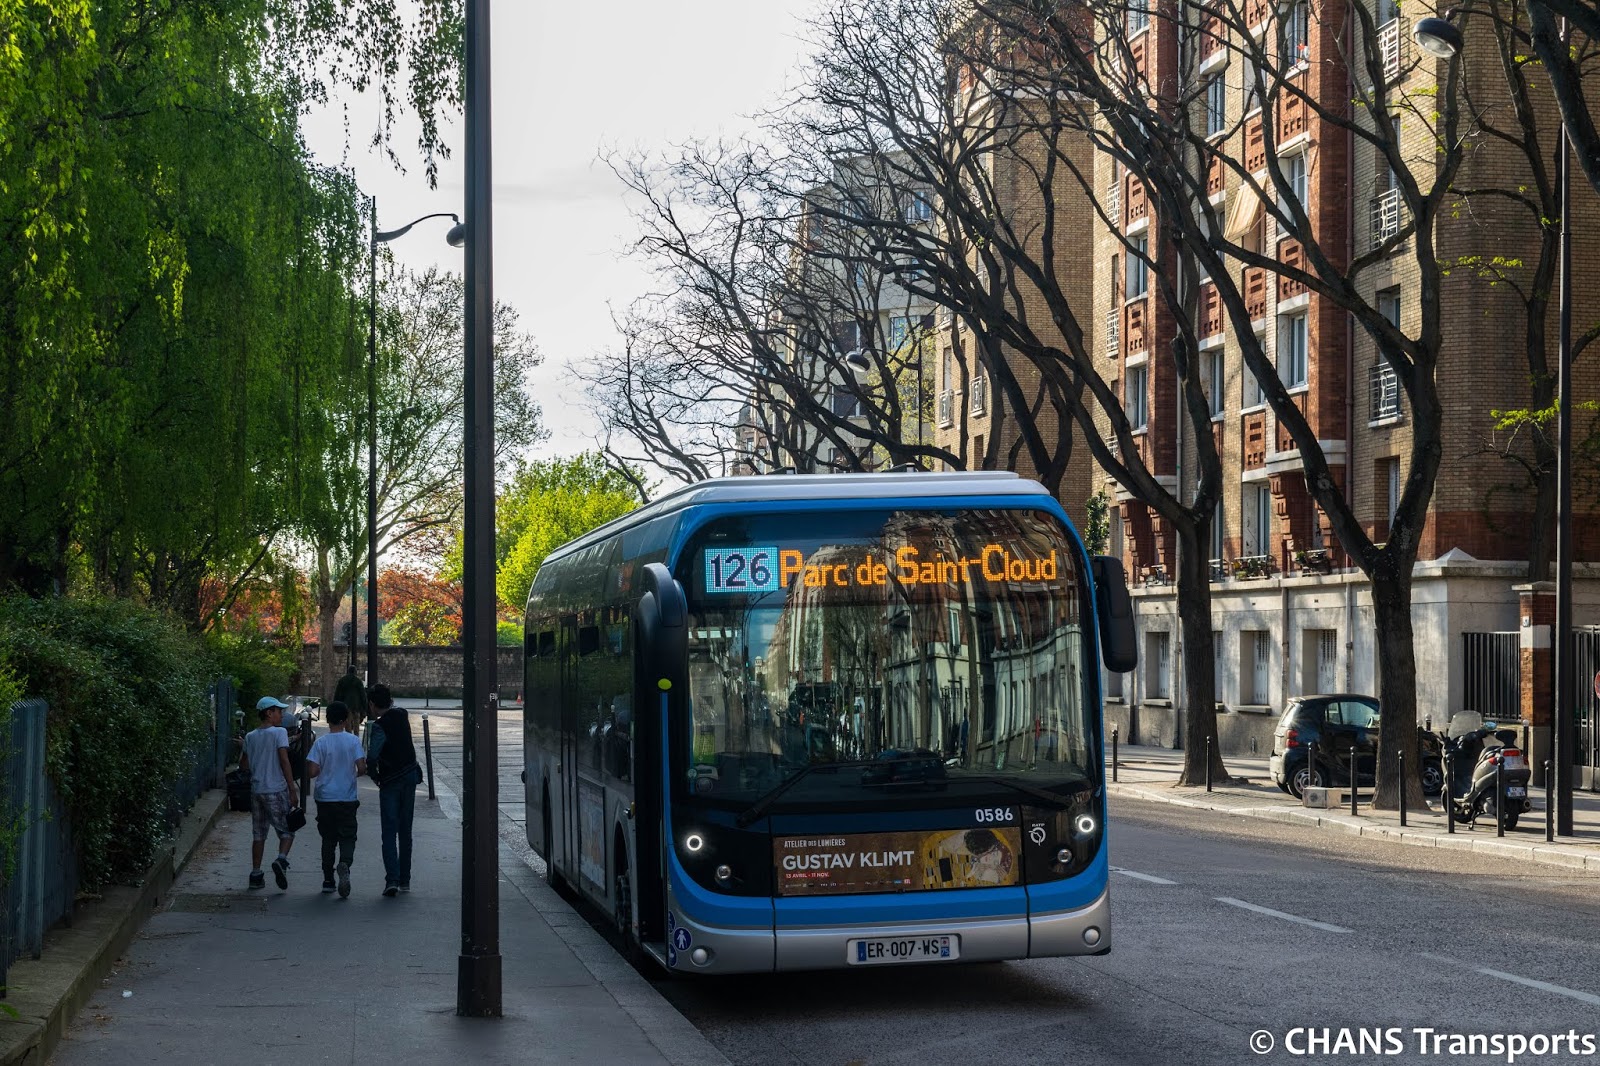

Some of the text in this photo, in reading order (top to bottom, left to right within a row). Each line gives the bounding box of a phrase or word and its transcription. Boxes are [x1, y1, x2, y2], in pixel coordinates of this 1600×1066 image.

[709, 552, 772, 588] 126
[779, 544, 1057, 588] Parc de Saint-Cloud
[975, 807, 1014, 823] 0586
[784, 840, 808, 848] ATELIER
[782, 850, 915, 871] GUSTAV KLIMT
[867, 939, 940, 958] ER-007-WS
